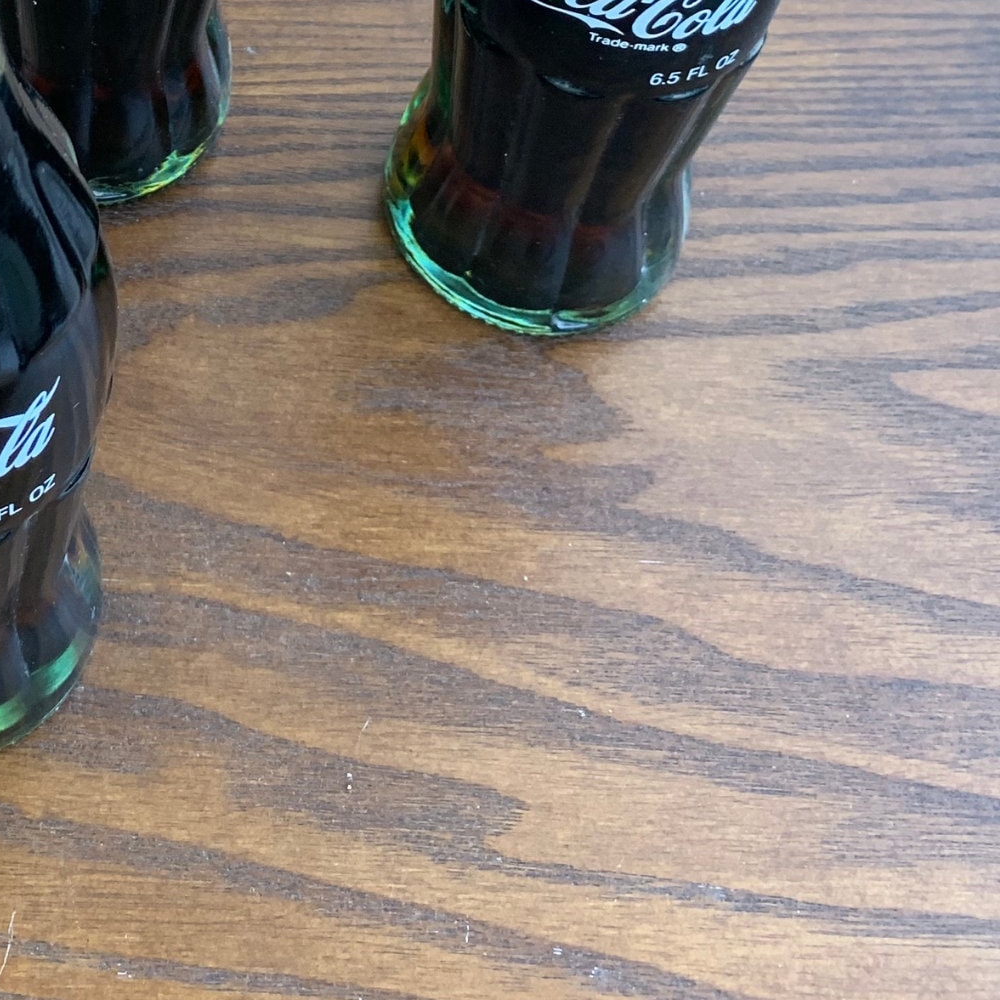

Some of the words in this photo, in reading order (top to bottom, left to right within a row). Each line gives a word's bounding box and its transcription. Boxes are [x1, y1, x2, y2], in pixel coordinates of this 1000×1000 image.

[649, 71, 680, 86] 6.5
[686, 66, 708, 81] FL
[714, 49, 739, 70] OZ
[28, 473, 56, 503] OZ
